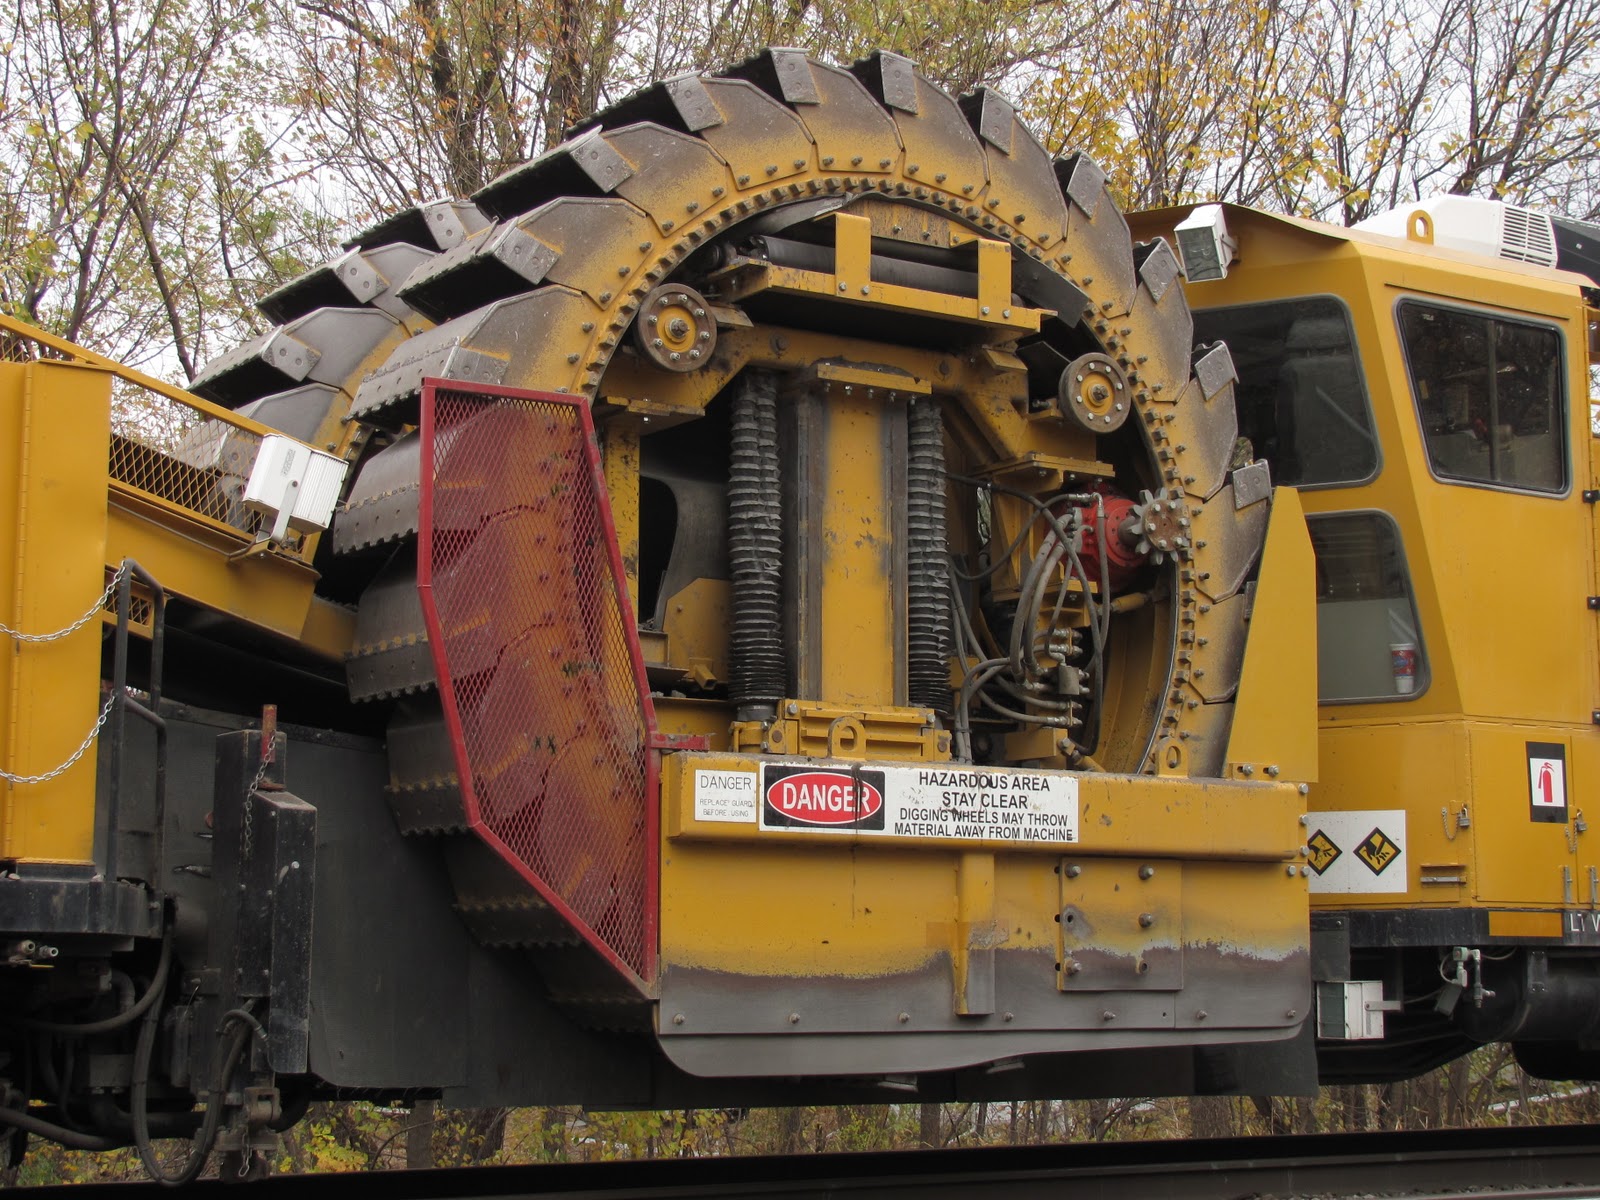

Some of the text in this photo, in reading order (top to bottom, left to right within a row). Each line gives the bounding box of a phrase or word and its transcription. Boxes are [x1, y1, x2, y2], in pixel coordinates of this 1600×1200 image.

[700, 775, 752, 790] DANGER
[919, 771, 1050, 791] HAZARDOUS AREA
[700, 798, 728, 806] REPLACE
[783, 782, 871, 813] DANGER
[942, 791, 1028, 809] STAY CLEAR
[900, 808, 1068, 827] DIGGING WHEELS MAY THROW
[894, 823, 1073, 841] MATERIAL AWAY FROM MACHINE
